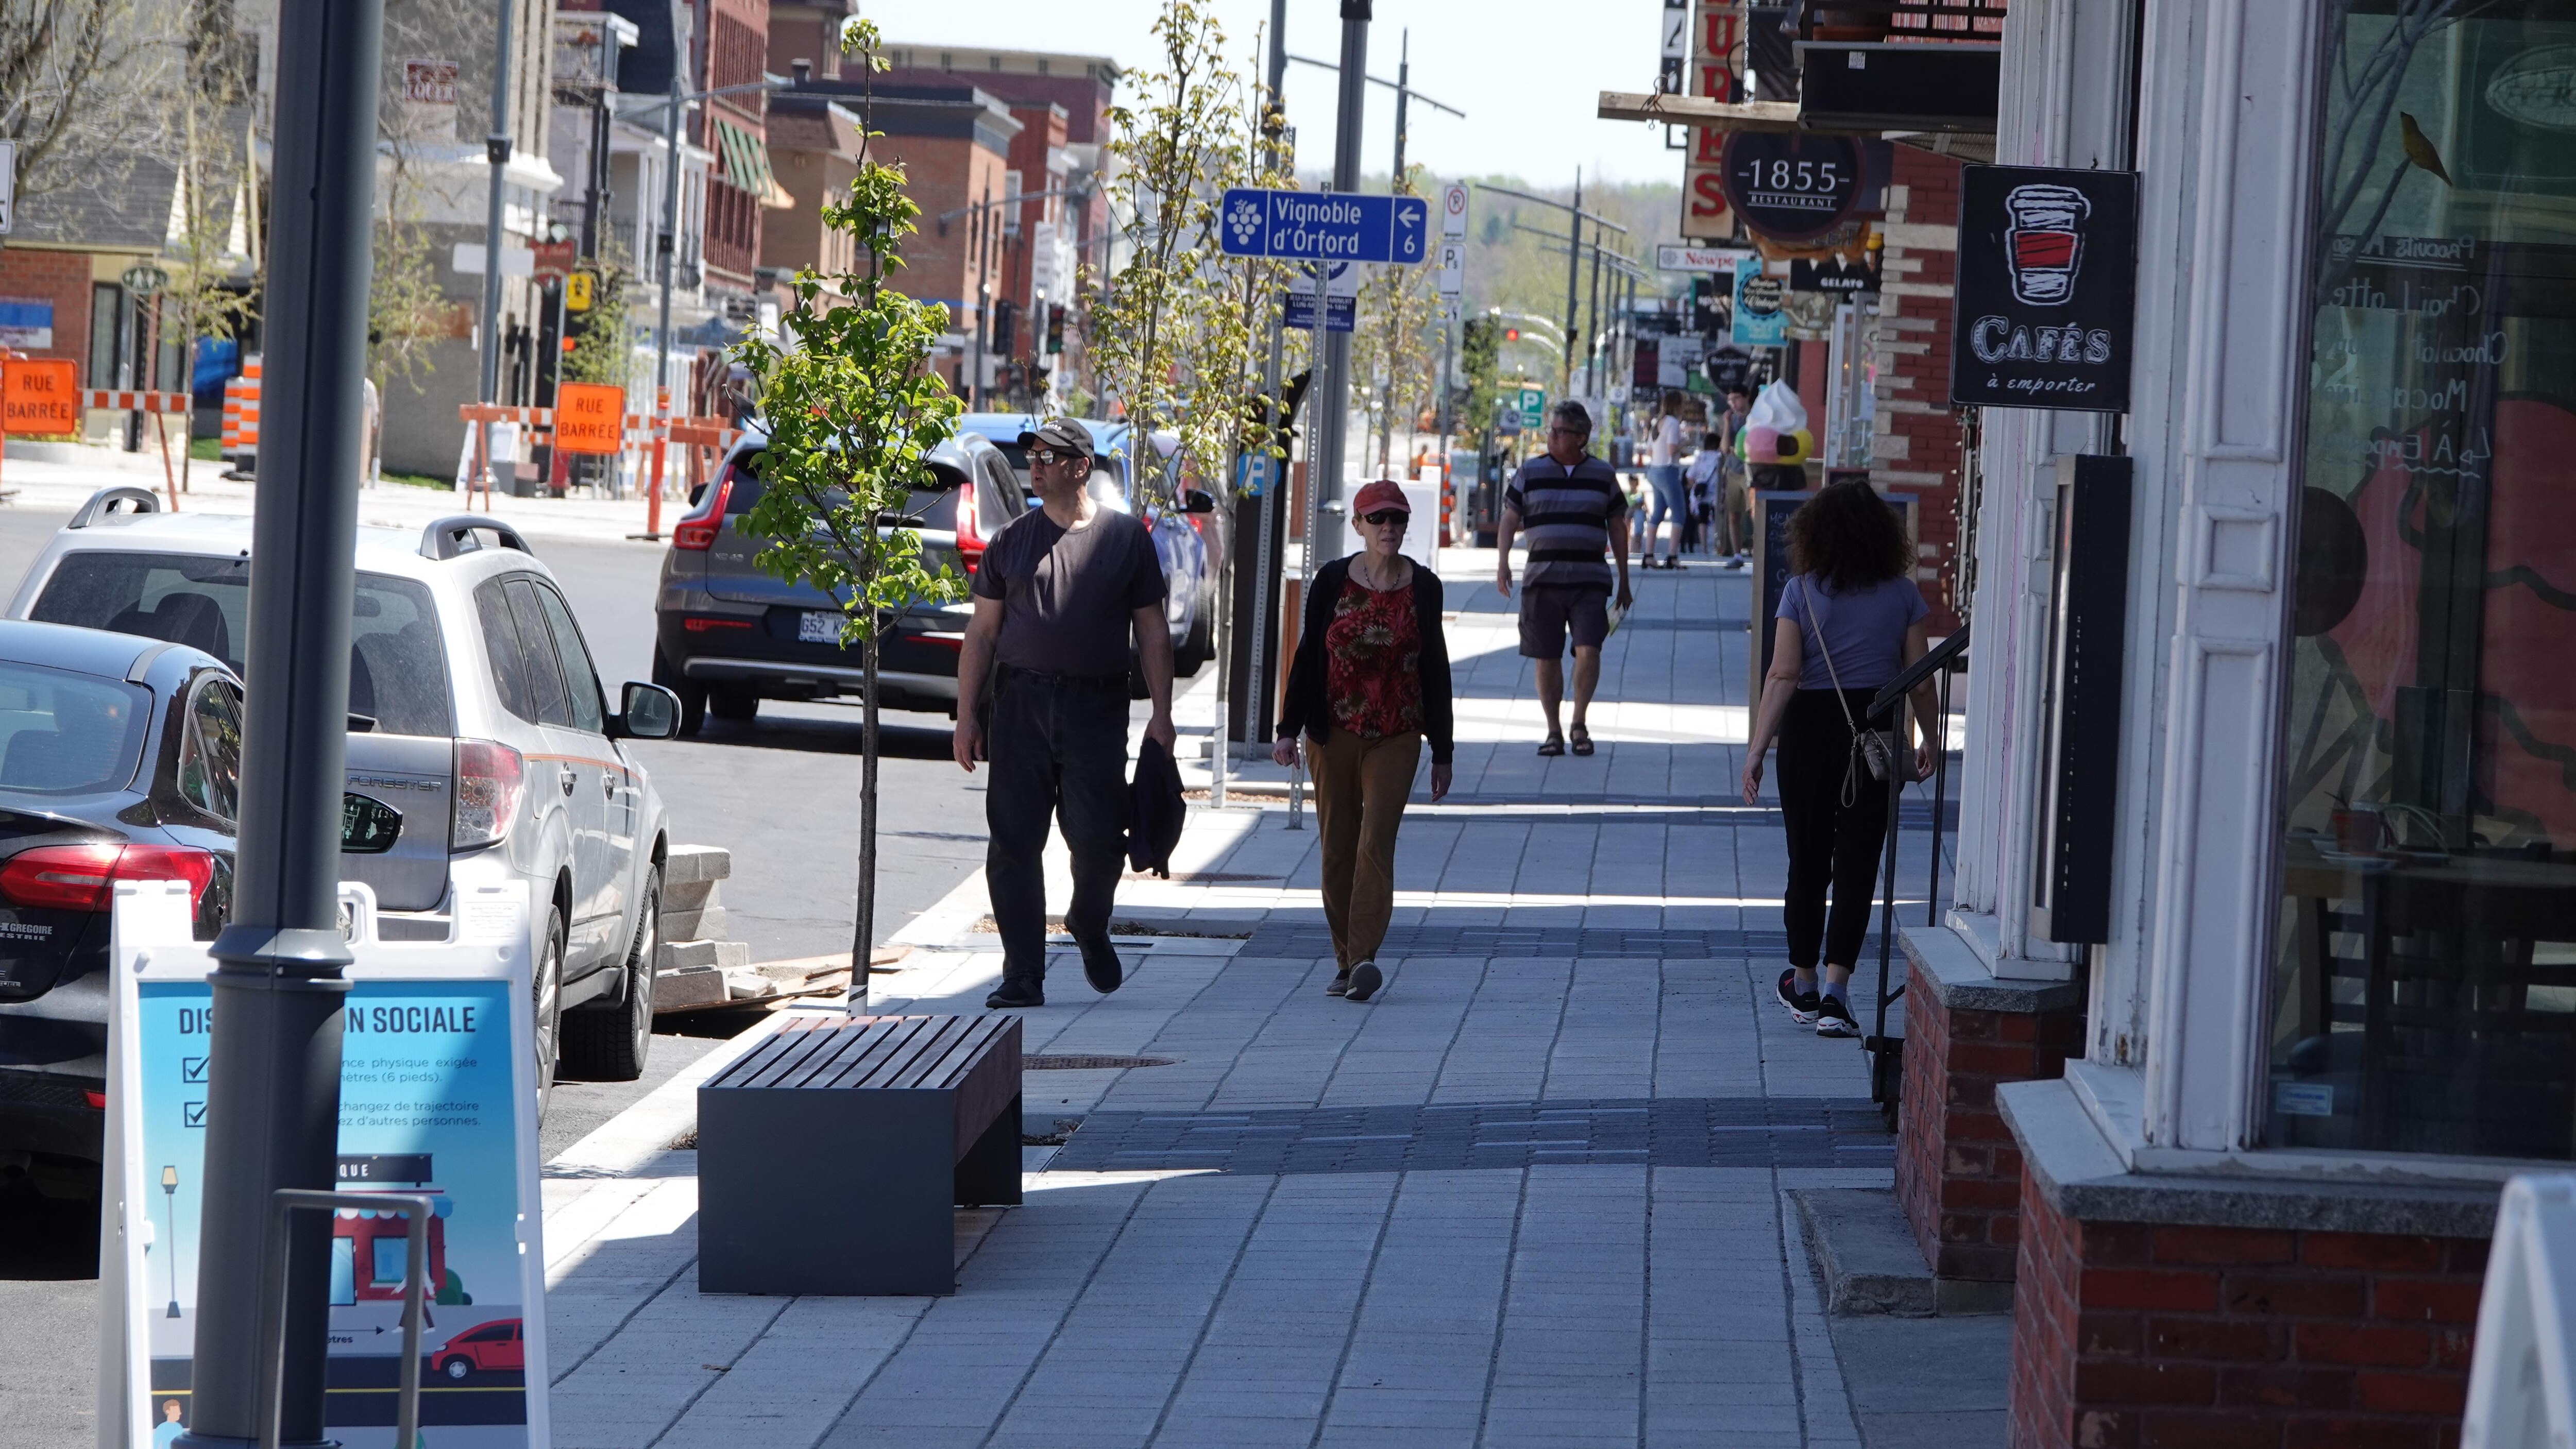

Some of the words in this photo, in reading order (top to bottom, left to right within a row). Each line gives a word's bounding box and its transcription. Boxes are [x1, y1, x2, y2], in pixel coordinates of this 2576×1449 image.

[1751, 194, 1833, 208] RESTAURANT
[1276, 197, 1362, 228] Vignoble
[1273, 227, 1359, 254] d'Orford
[1404, 234, 1416, 254] 6
[1685, 250, 1735, 269] Newpo
[1820, 277, 1864, 289] GELATO
[1971, 315, 2111, 364] CAFÉS
[23, 374, 54, 390] RUE
[1987, 372, 1999, 387] à
[2006, 377, 2096, 396] emporter
[7, 399, 69, 419] BARRÉE
[576, 397, 603, 413] RUE
[1523, 392, 1539, 412] P
[560, 421, 616, 439] BARRÉE
[347, 774, 442, 791] FORESTER
[0, 932, 46, 941] ESTRIE
[372, 1007, 476, 1033] SOCIALE
[342, 1059, 365, 1067] nce
[371, 1058, 429, 1069] physique
[435, 1057, 478, 1069] exigée
[382, 1072, 396, 1082] (6
[399, 1071, 443, 1084] pieds).
[394, 1101, 410, 1111] de
[414, 1101, 479, 1113] trajectoire
[338, 1117, 353, 1126] ez
[357, 1116, 408, 1126] d'autres
[412, 1117, 481, 1127] personnes.
[339, 1164, 369, 1178] QUE
